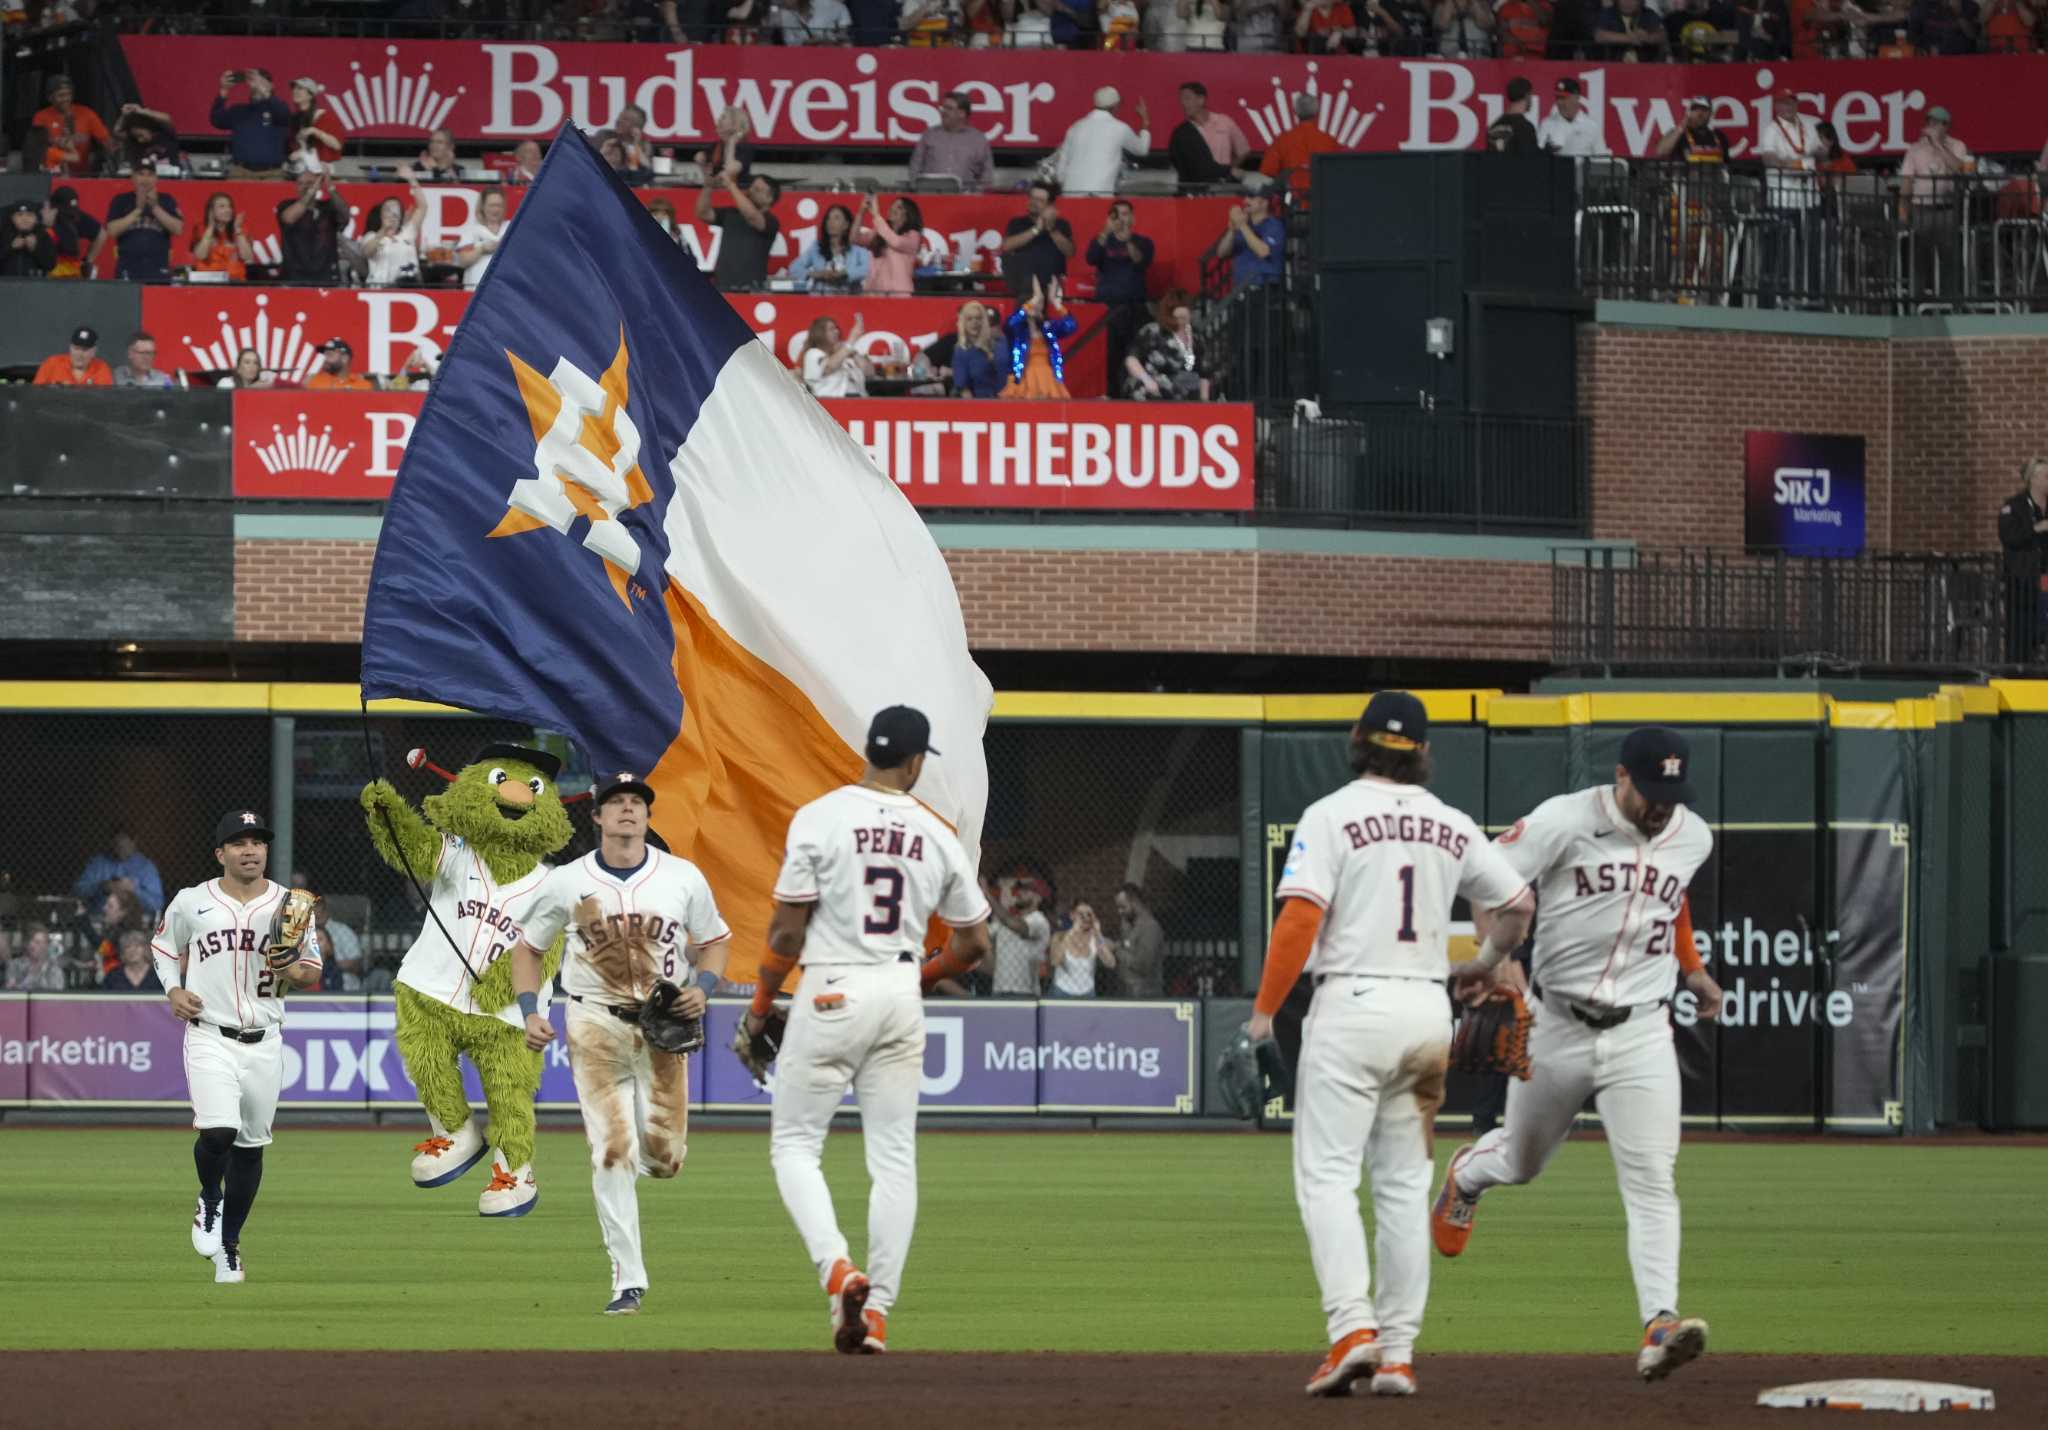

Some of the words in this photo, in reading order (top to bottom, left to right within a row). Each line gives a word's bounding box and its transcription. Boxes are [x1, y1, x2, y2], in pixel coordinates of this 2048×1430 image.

[481, 43, 1056, 142] Budweiser
[1793, 507, 1843, 527] Marketing
[629, 583, 648, 600] TM
[853, 822, 924, 861] PEÑA
[1343, 813, 1469, 861] RODGERS
[864, 867, 904, 935] 3
[1397, 865, 1417, 942] 1
[457, 900, 518, 942] ASTROS
[576, 912, 680, 951] ASTROS
[663, 949, 674, 978] 6
[0, 1036, 152, 1072] arketing
[984, 1041, 1161, 1079] Marketing
